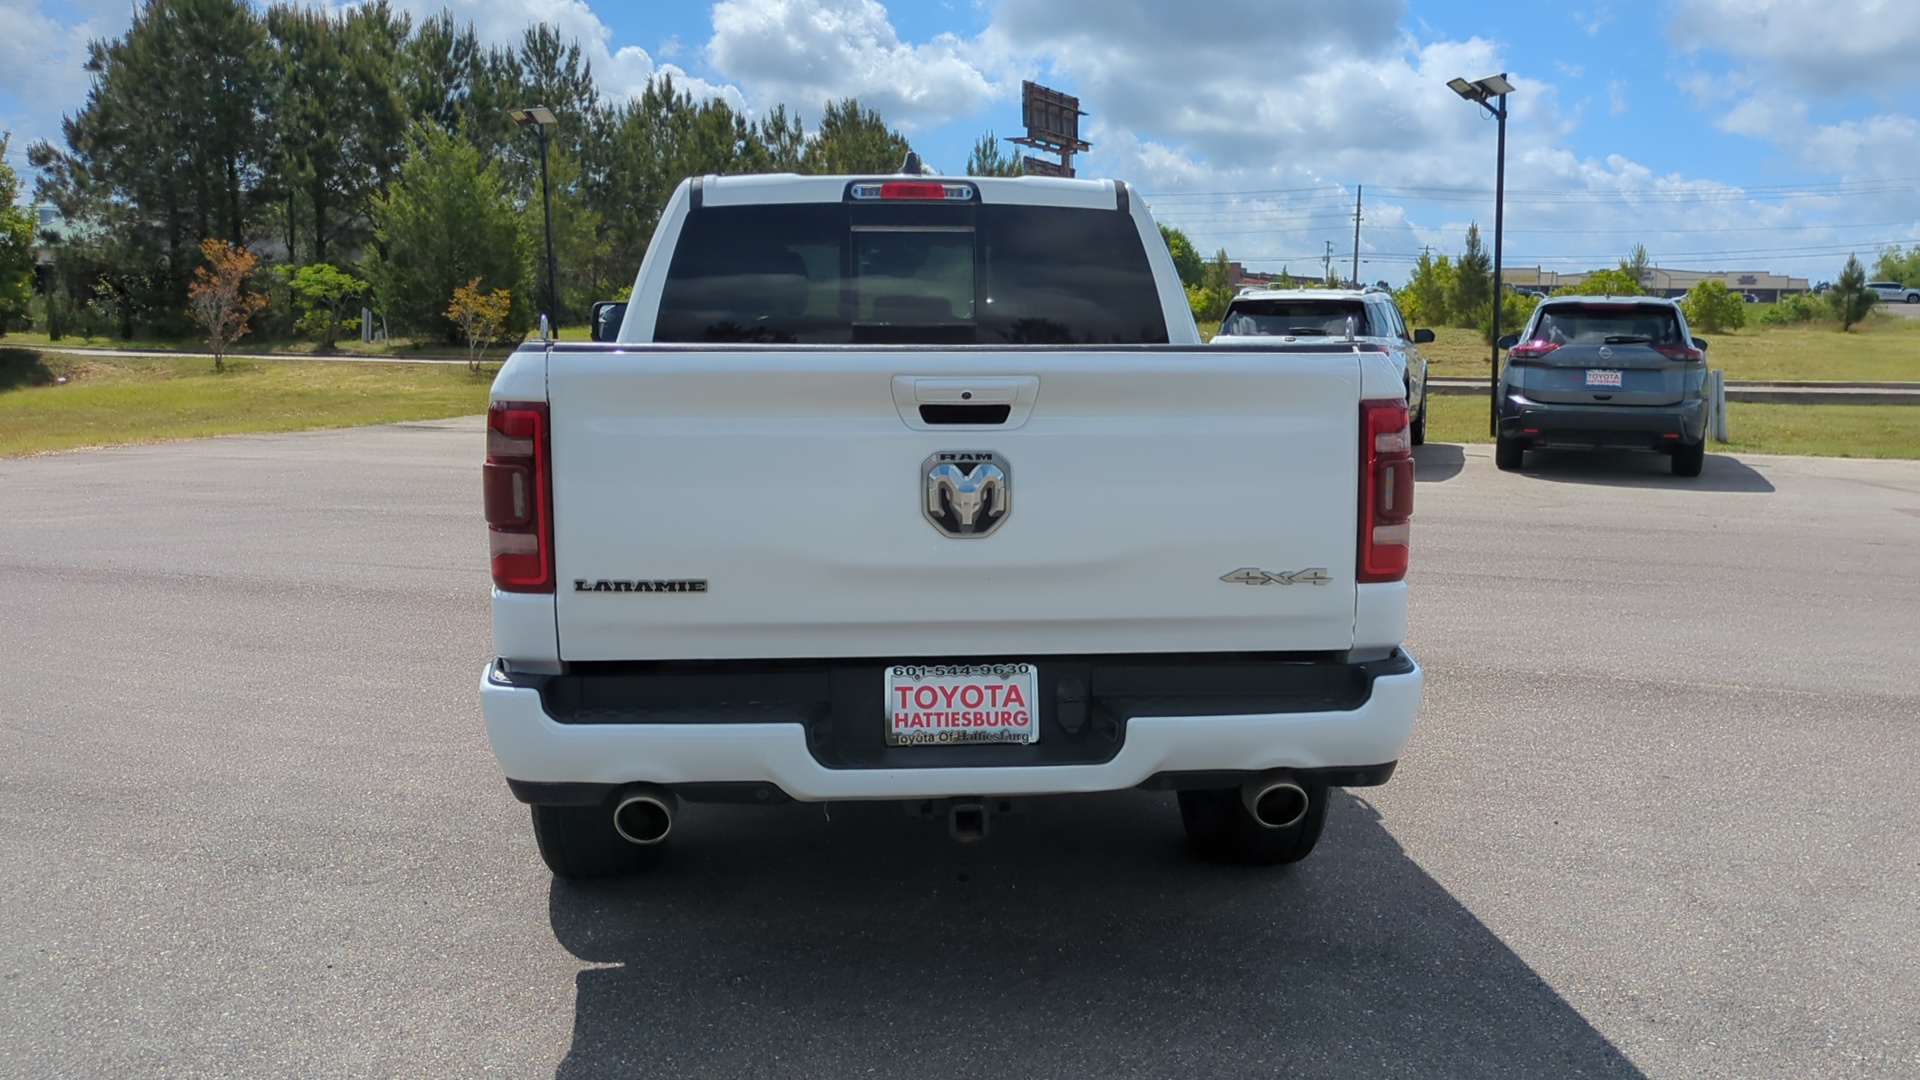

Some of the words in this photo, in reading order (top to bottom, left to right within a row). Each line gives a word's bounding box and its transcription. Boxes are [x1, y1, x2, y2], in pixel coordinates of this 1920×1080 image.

[940, 453, 993, 461] RAM
[574, 579, 707, 593] LARAMIE
[892, 664, 1030, 676] 601-544-9630
[894, 685, 1026, 709] TOYOTA
[894, 711, 1029, 728] HATTIESBURG
[895, 733, 935, 745] Toyota
[938, 731, 955, 742] Of
